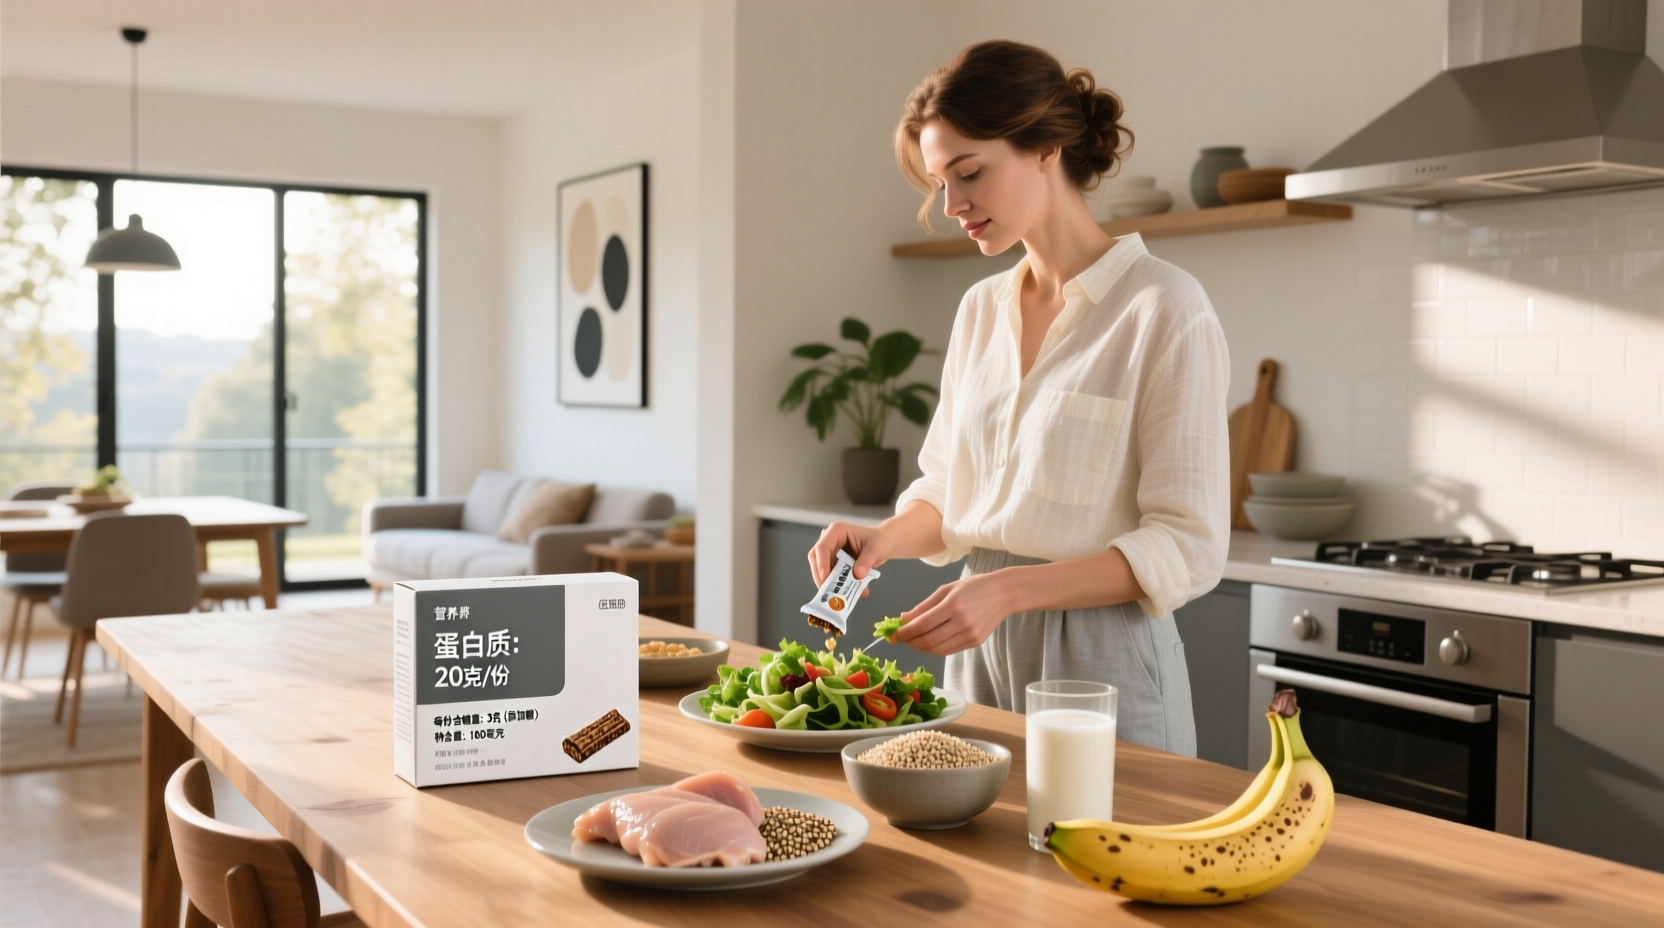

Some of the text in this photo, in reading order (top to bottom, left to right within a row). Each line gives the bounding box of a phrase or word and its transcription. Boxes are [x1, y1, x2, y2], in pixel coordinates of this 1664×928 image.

[434, 629, 519, 659] 蛋白质:
[434, 664, 510, 688] 20克/份
